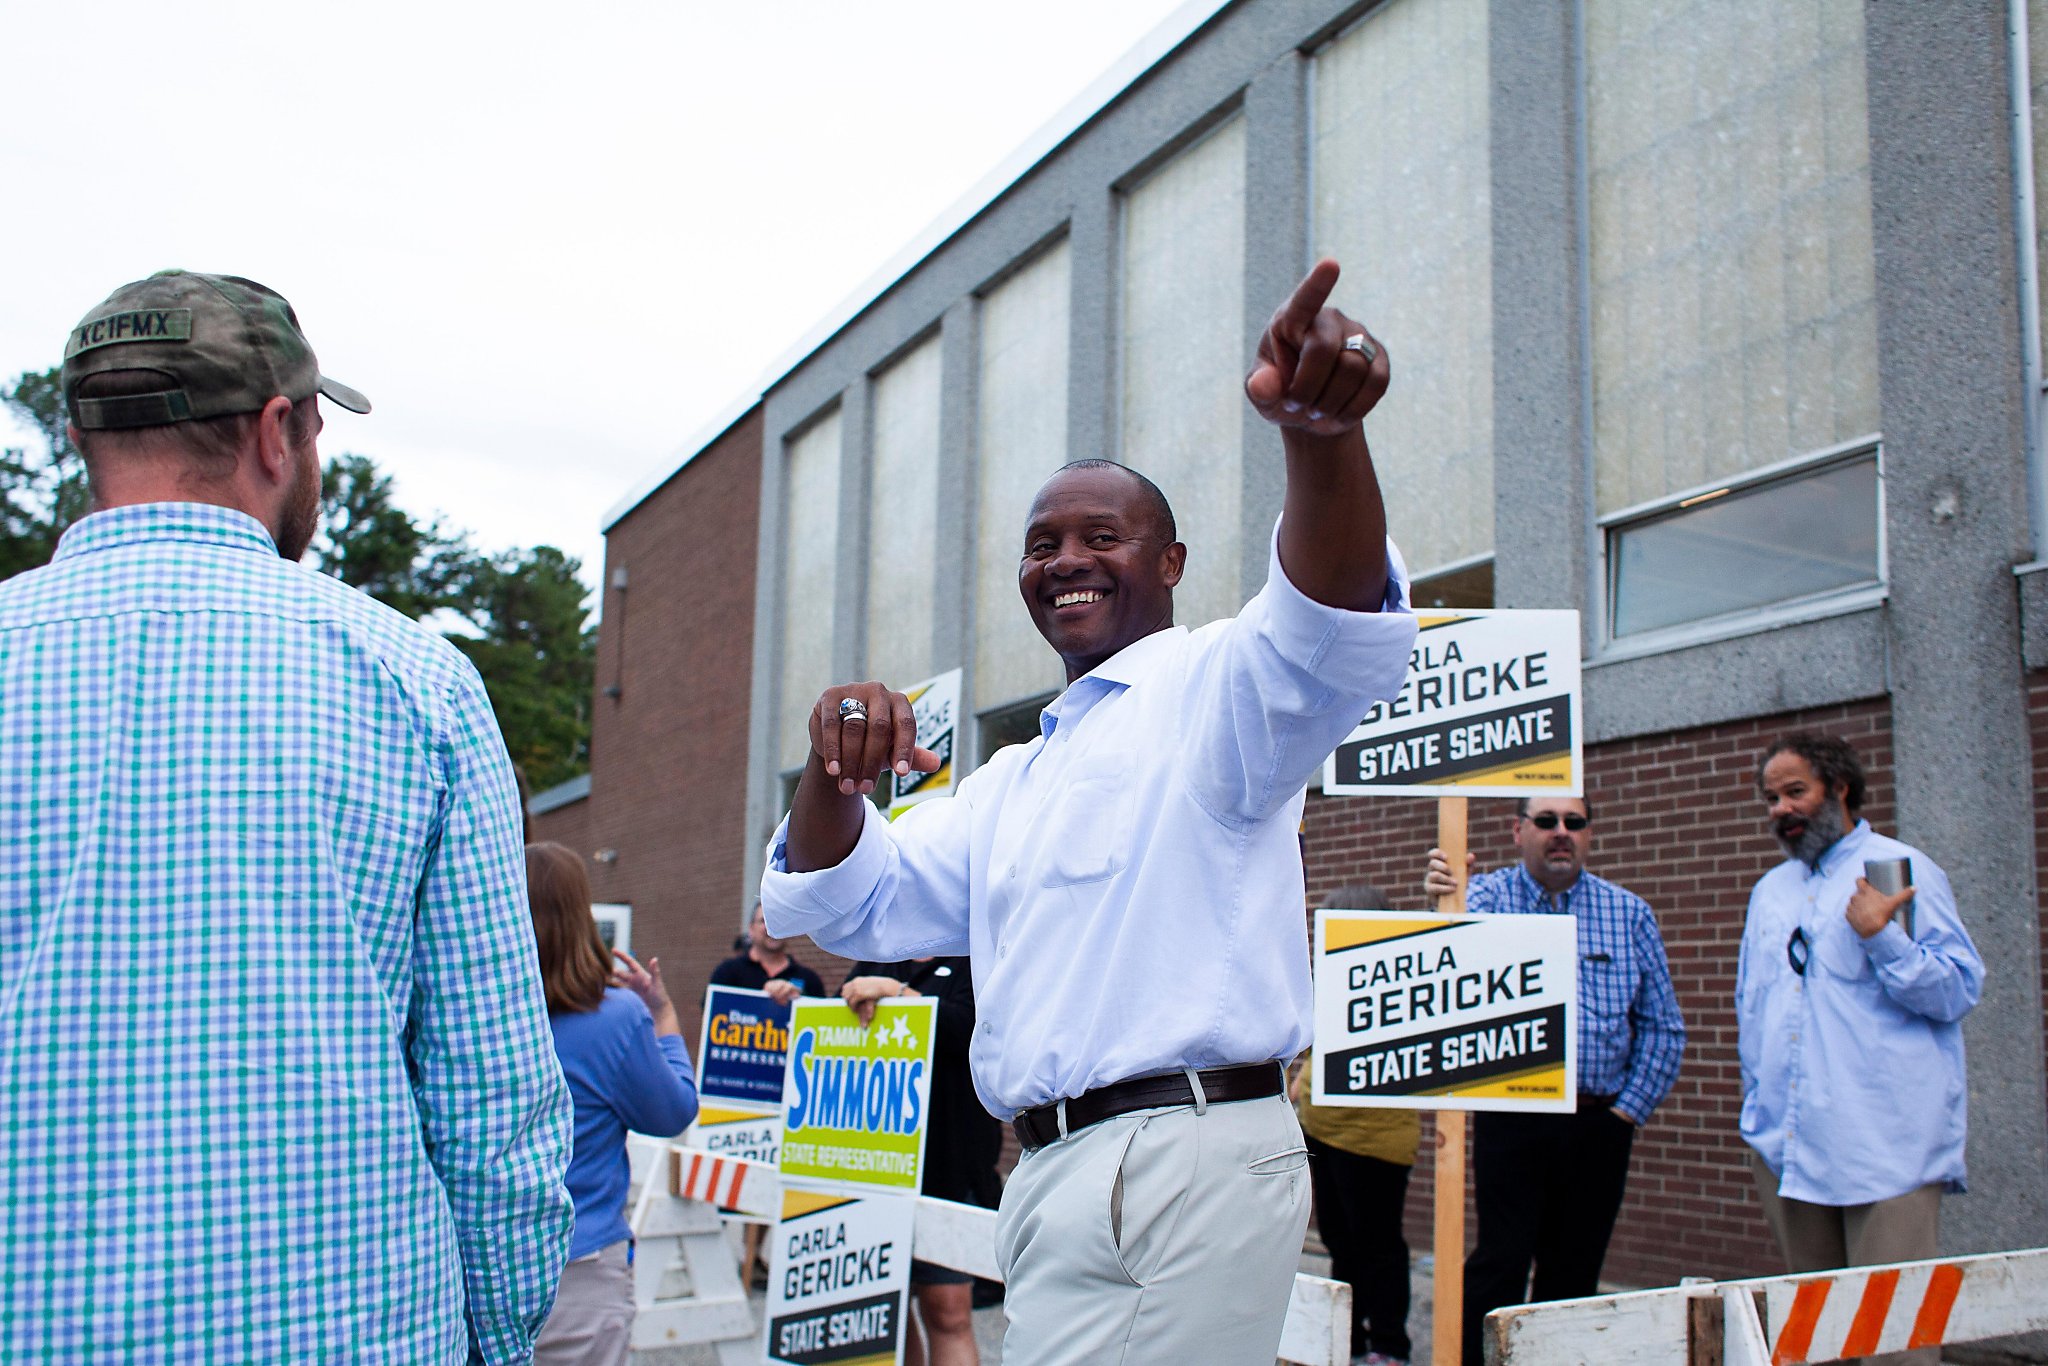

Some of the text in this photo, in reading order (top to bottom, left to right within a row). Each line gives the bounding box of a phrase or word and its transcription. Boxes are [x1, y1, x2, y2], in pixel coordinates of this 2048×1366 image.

[1359, 707, 1554, 781] STATE SENATE
[1348, 945, 1457, 991] CARLA
[1347, 959, 1543, 1034] GERICKE
[818, 1026, 871, 1048] TAMMY
[1349, 1017, 1548, 1091] STATE SENATE
[786, 1029, 924, 1136] SIMMONS
[708, 1128, 772, 1151] CARLA
[782, 1142, 816, 1167] STATE
[817, 1145, 917, 1177] REPRESENTATIVE
[788, 1221, 846, 1261] CARLA
[784, 1241, 893, 1301] GERICKE
[778, 1302, 892, 1357] STATE SENATE
